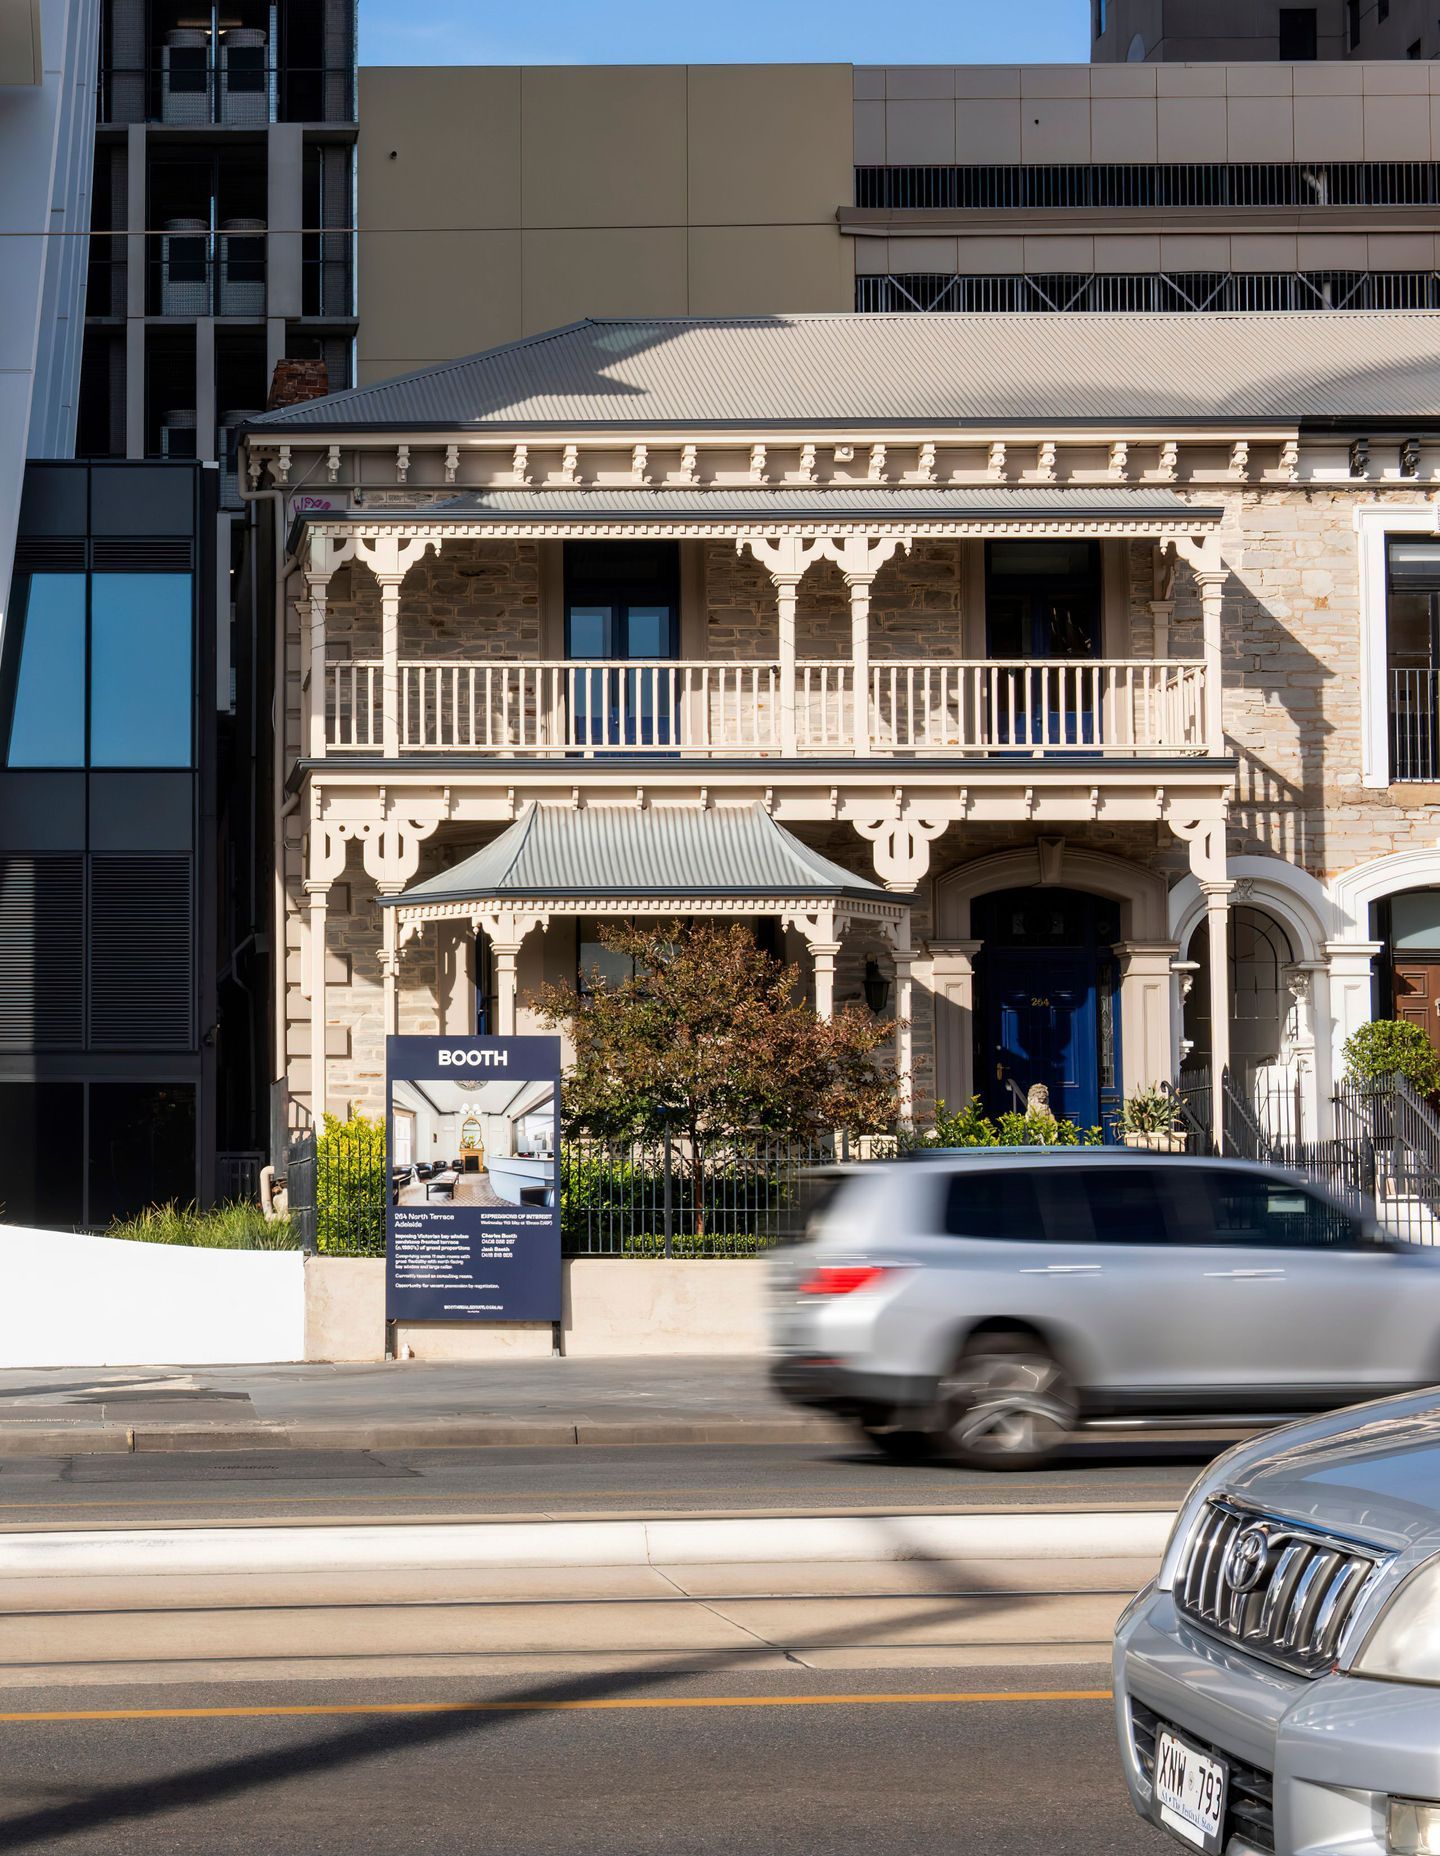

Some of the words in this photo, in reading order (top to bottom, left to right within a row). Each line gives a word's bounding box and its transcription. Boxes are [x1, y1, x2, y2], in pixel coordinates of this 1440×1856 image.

[438, 1050, 508, 1066] BOOTH
[1158, 1742, 1187, 1798] XNW
[1197, 1766, 1223, 1821] 793
